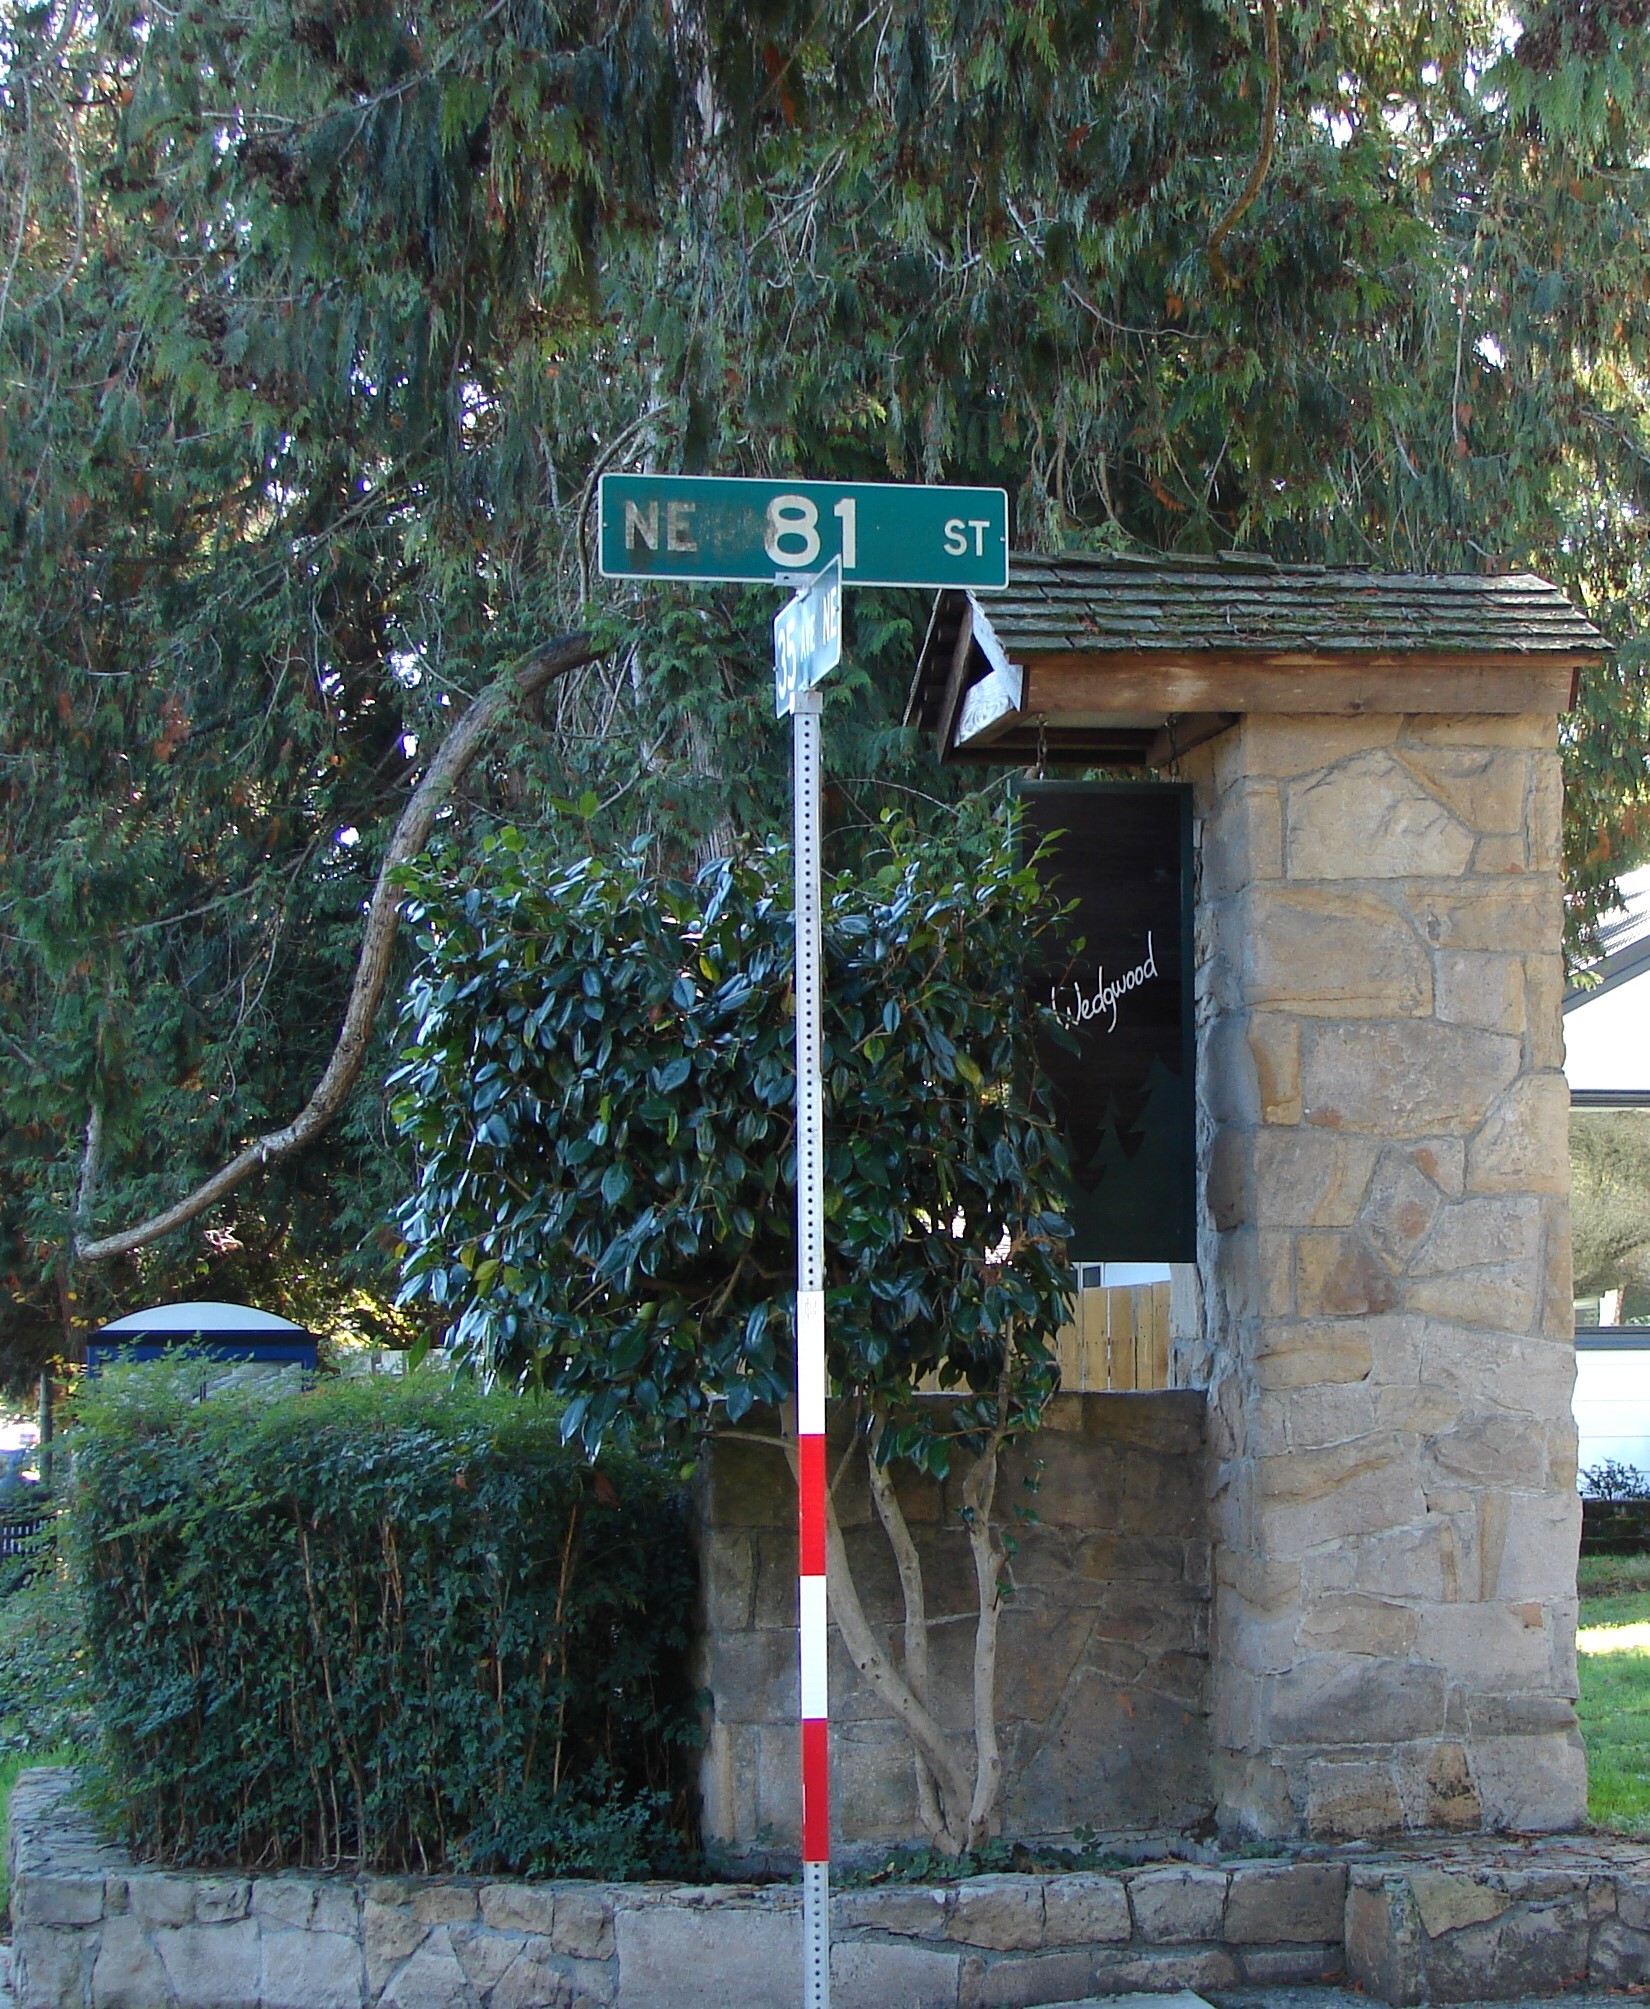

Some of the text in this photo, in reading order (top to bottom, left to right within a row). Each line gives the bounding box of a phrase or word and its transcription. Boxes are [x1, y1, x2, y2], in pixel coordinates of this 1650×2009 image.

[624, 494, 990, 568] NE 81 ST
[777, 586, 838, 700] 35 AVE NE
[1051, 930, 1159, 1033] Wedgwood
